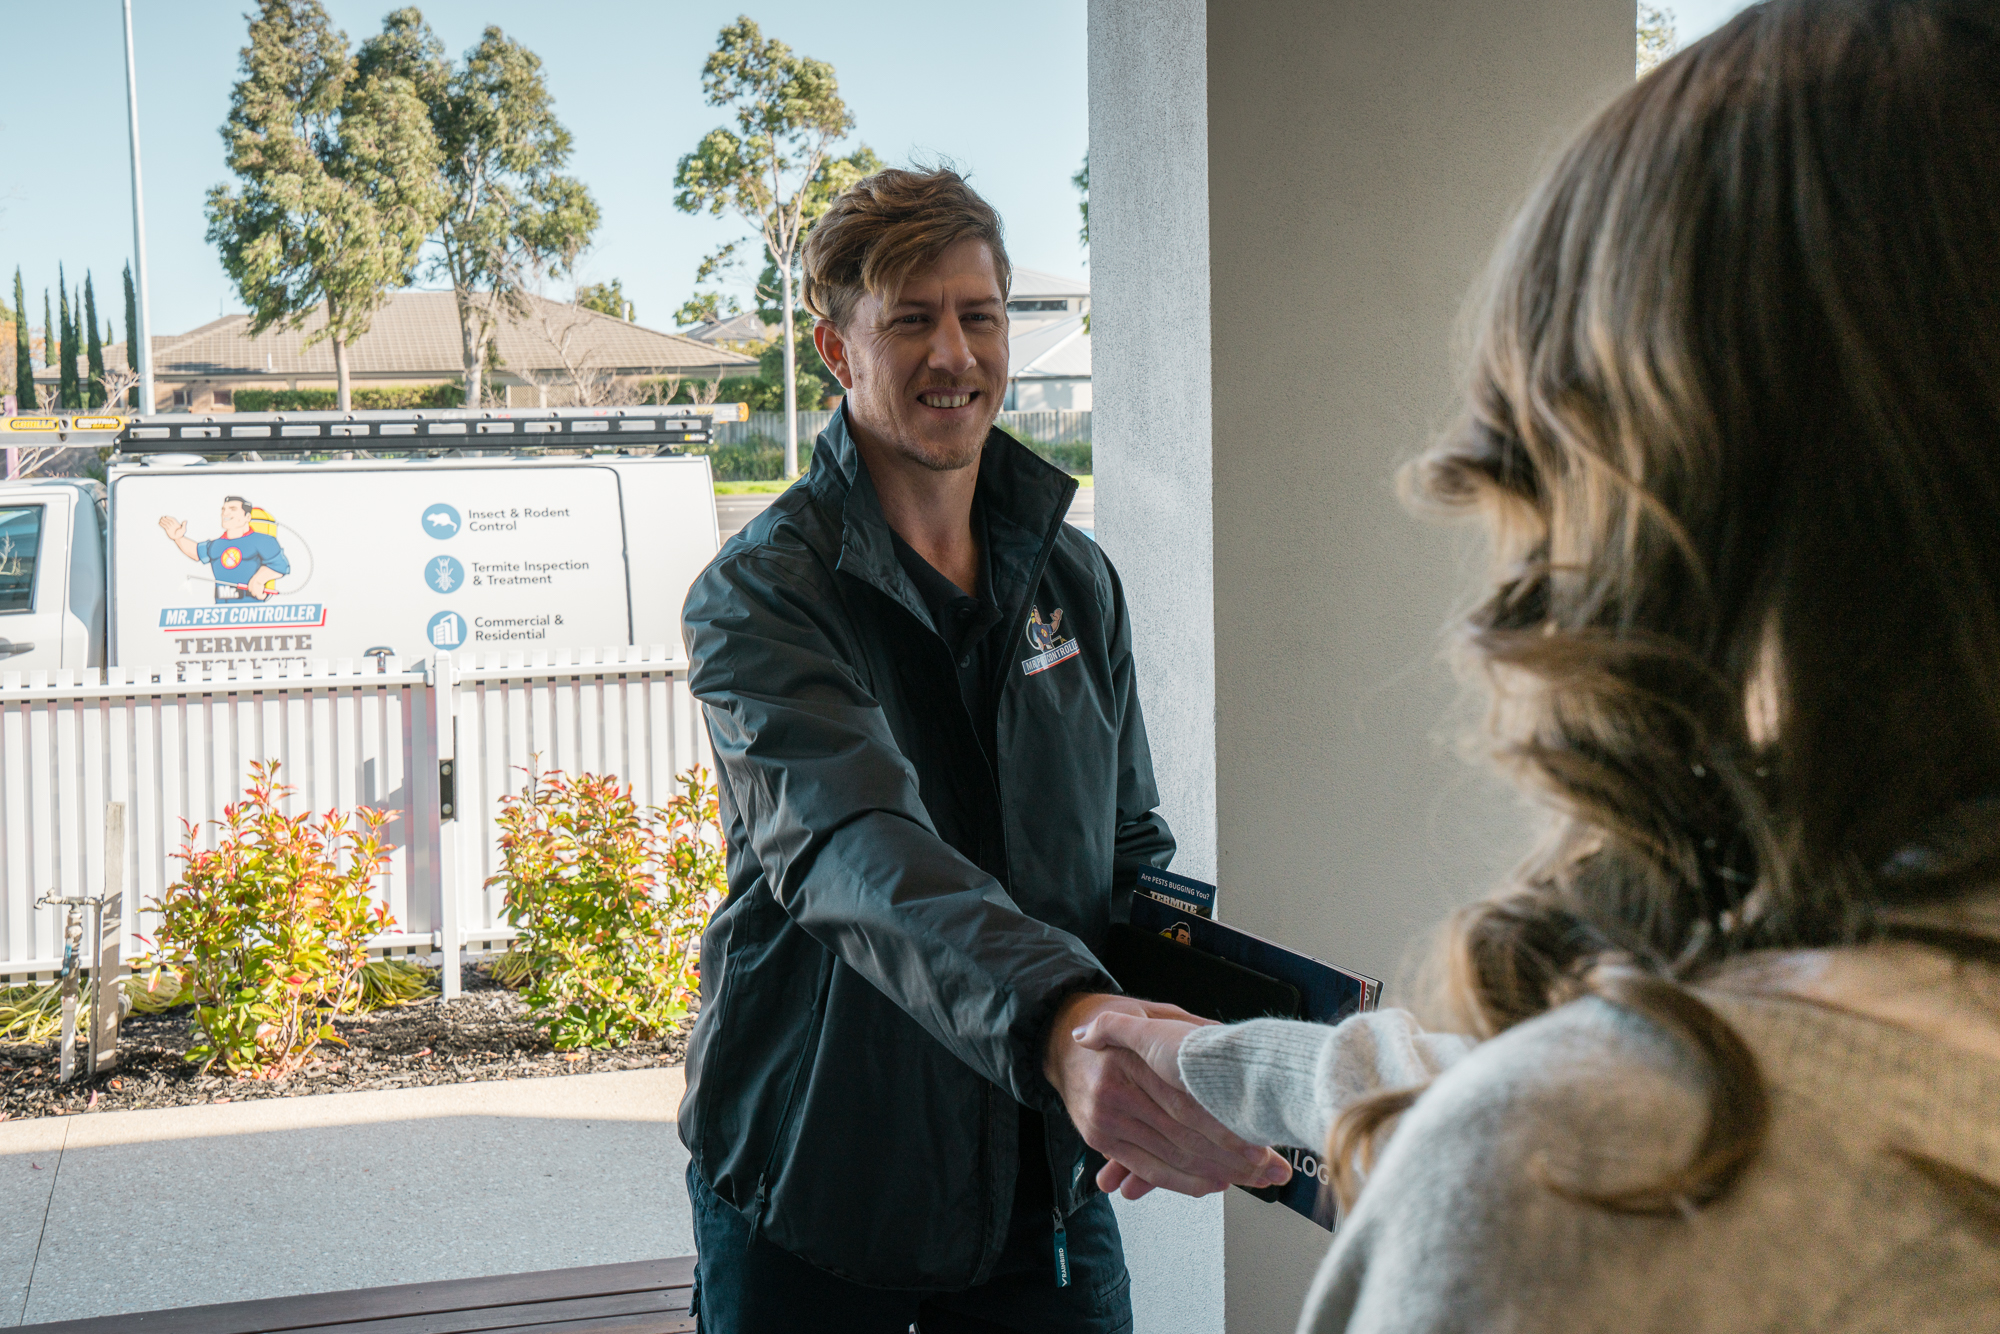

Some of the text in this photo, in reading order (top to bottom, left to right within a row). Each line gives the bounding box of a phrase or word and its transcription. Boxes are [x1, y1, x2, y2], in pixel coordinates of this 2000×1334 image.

[11, 420, 55, 429] GORILLA
[468, 507, 570, 519] Insect & Rodent
[469, 520, 517, 532] Control
[471, 559, 590, 573] Termite Inspection
[473, 574, 553, 585] & Treatment
[218, 585, 239, 599] Mr.
[165, 605, 316, 625] MR. PEST CONTROLLER
[474, 614, 564, 628] Commercial &
[475, 628, 546, 641] Residential
[174, 634, 312, 655] TERMITE
[1047, 640, 1079, 663] CONTROLLE
[1141, 873, 1210, 900] Are PESTS BUGGING You?
[1150, 890, 1198, 914] TERMITE
[1059, 1247, 1067, 1278] RAINBIRD
